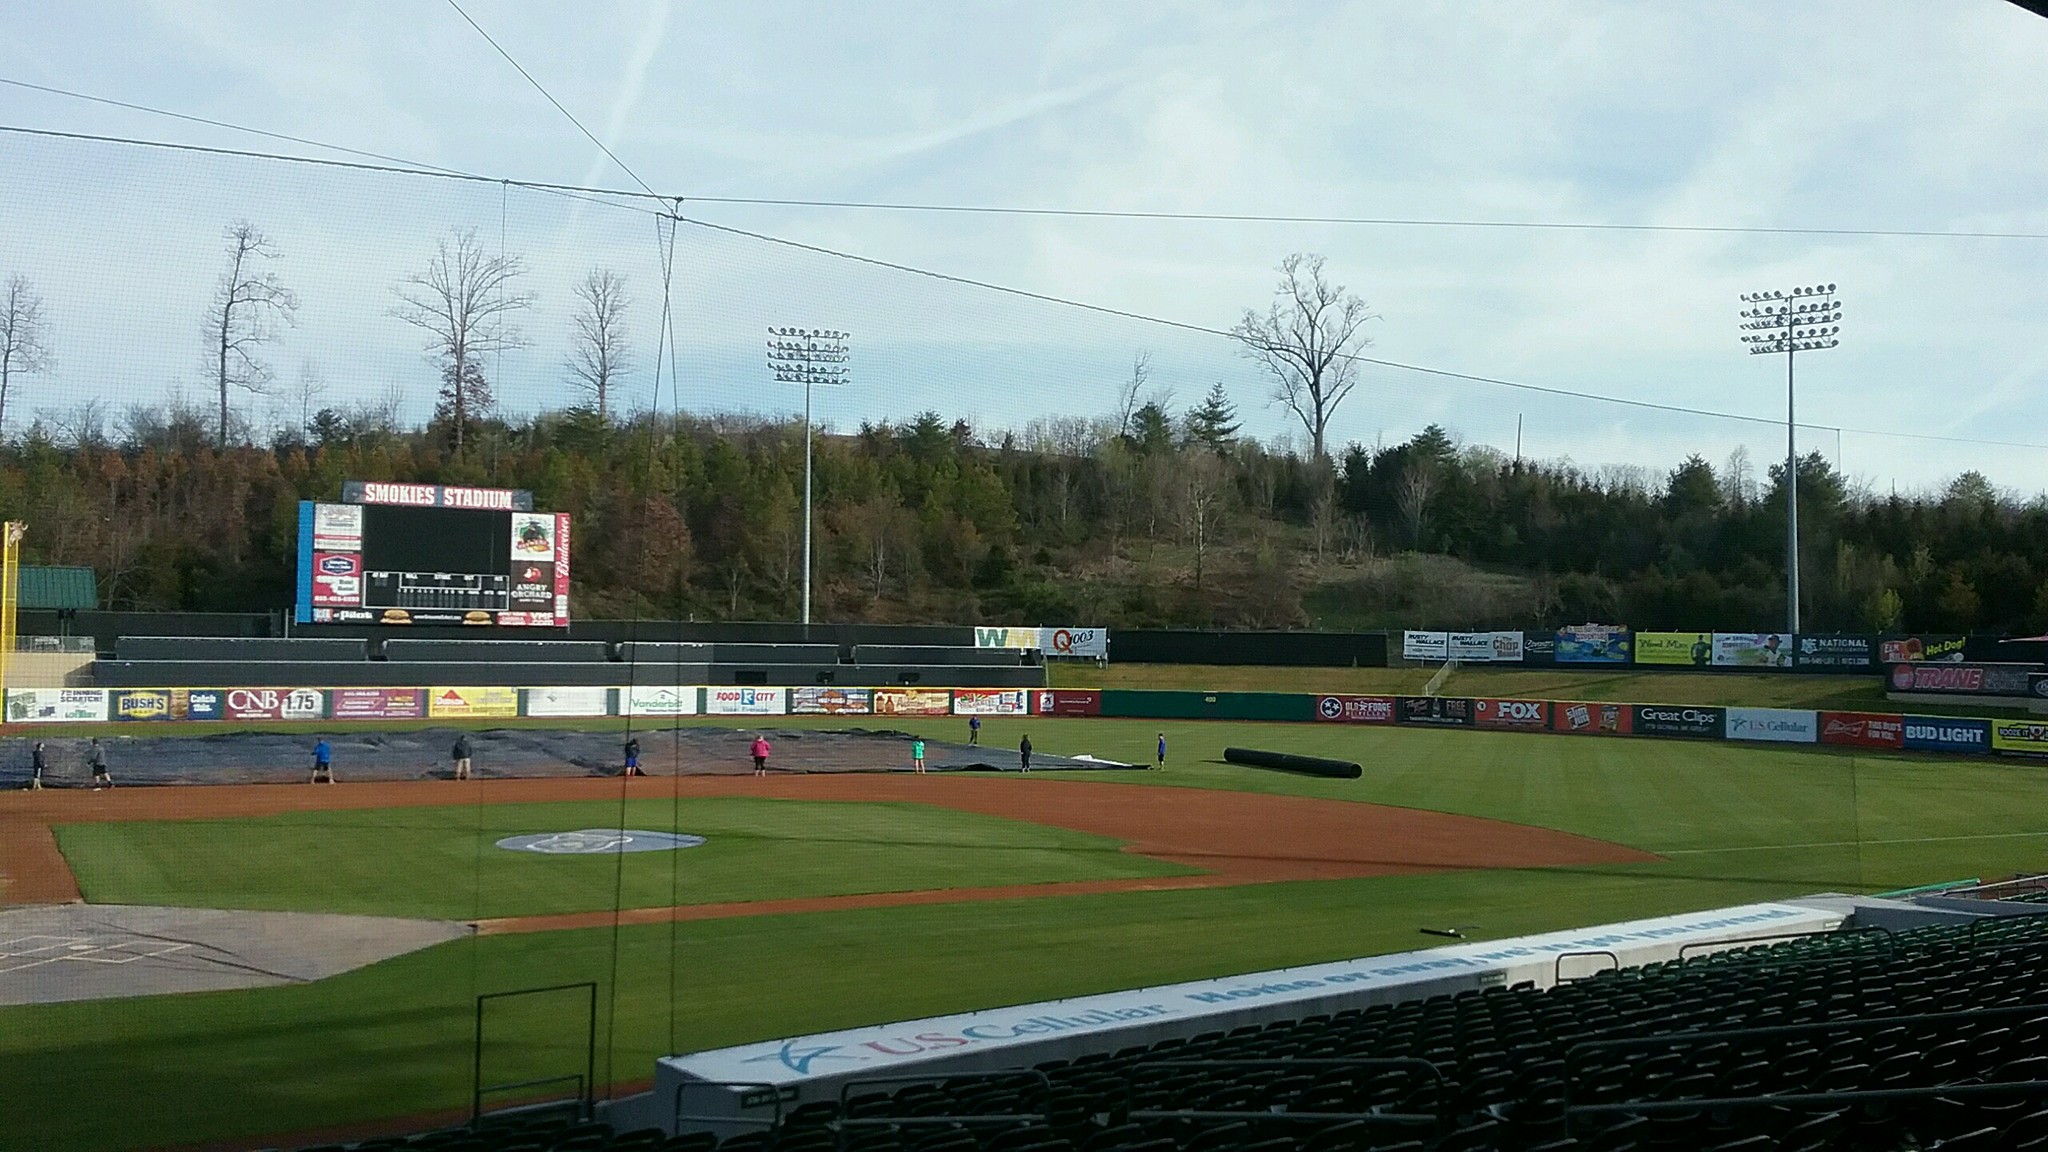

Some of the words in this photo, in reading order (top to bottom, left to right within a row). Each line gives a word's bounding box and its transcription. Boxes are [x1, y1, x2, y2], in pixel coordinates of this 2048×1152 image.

[365, 483, 435, 504] SMOKIES
[444, 487, 512, 509] STADIUM
[555, 516, 569, 578] Budweiser
[511, 591, 553, 599] ORCHARD
[516, 583, 547, 591] ANGRY
[1492, 638, 1519, 650] Chop
[1819, 639, 1869, 647] NATIONAL
[1926, 645, 1943, 656] Hot
[1944, 636, 1967, 652] Dog!
[1914, 668, 1983, 690] TRANE
[122, 697, 165, 711] BUSH'S
[228, 690, 280, 710] CNB
[631, 698, 683, 708] Vanderbilt
[716, 692, 740, 701] FOOD
[755, 692, 775, 701] CITY
[1345, 701, 1358, 711] OLD
[1368, 702, 1391, 712] FORGE
[1498, 702, 1541, 719] FOX
[1641, 708, 1680, 721] Great
[1682, 709, 1715, 726] Clips
[1767, 720, 1808, 734] Cellular
[1906, 725, 1938, 741] BUD
[1939, 727, 1984, 743] LIGHT
[1184, 979, 1327, 1004] Home
[1323, 971, 1372, 984] or
[962, 1002, 1172, 1040] Cellular
